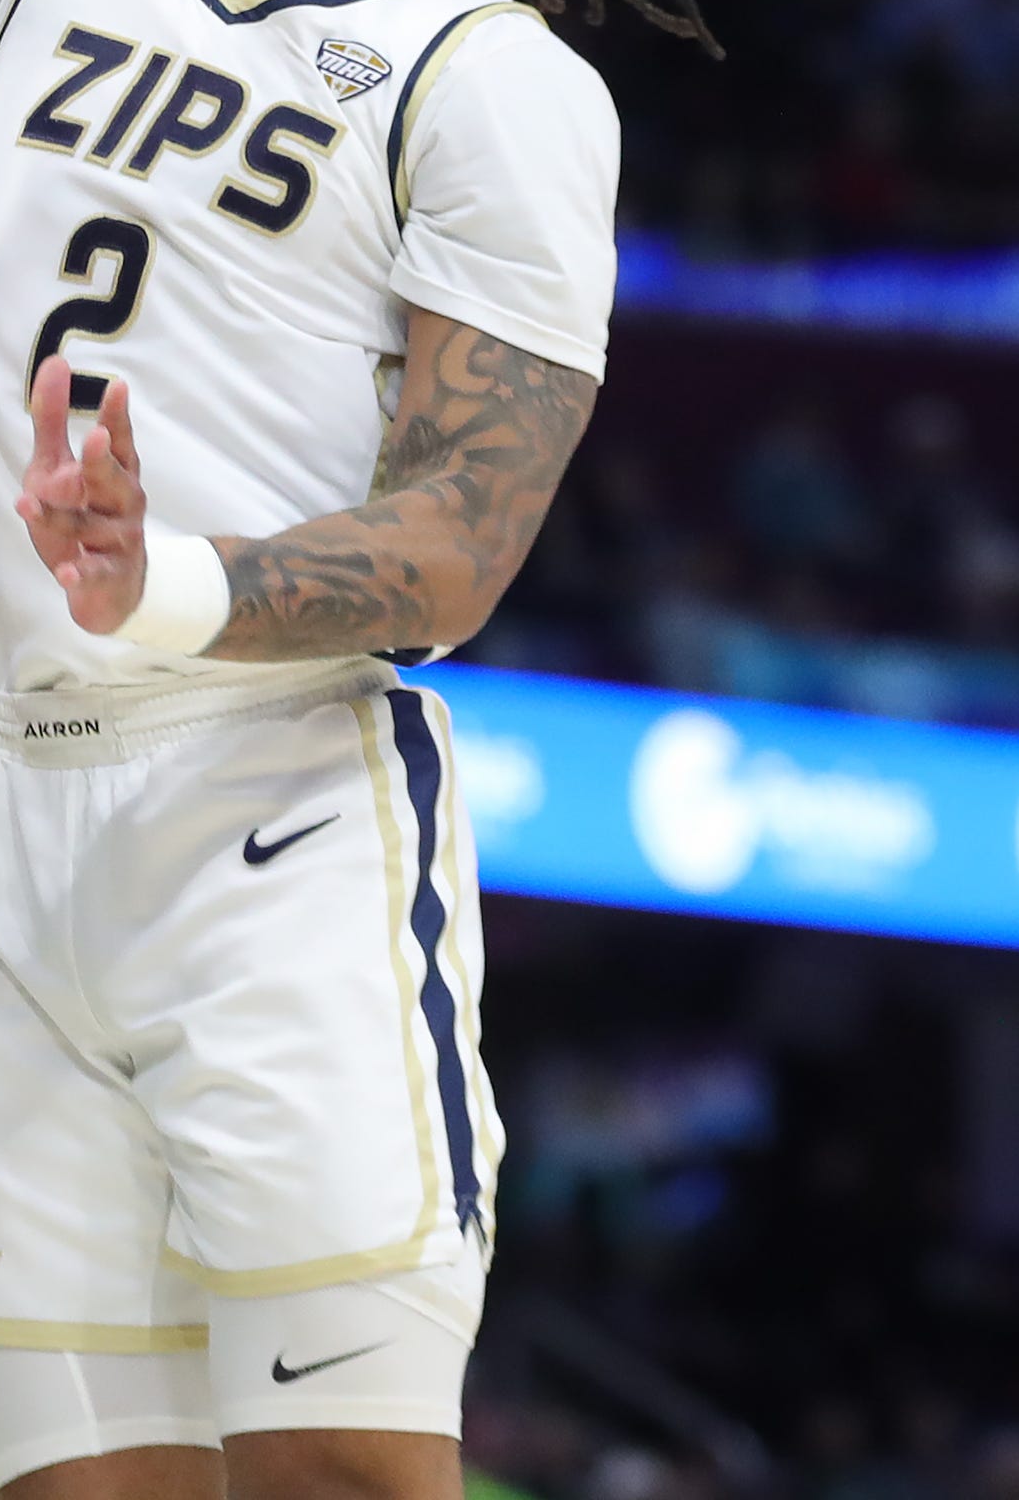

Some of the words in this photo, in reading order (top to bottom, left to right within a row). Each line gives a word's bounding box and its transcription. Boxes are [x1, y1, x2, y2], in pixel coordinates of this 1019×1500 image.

[15, 20, 348, 240] ZIPS
[317, 51, 386, 88] MAC
[24, 212, 157, 419] 2
[23, 718, 101, 741] AKRON
